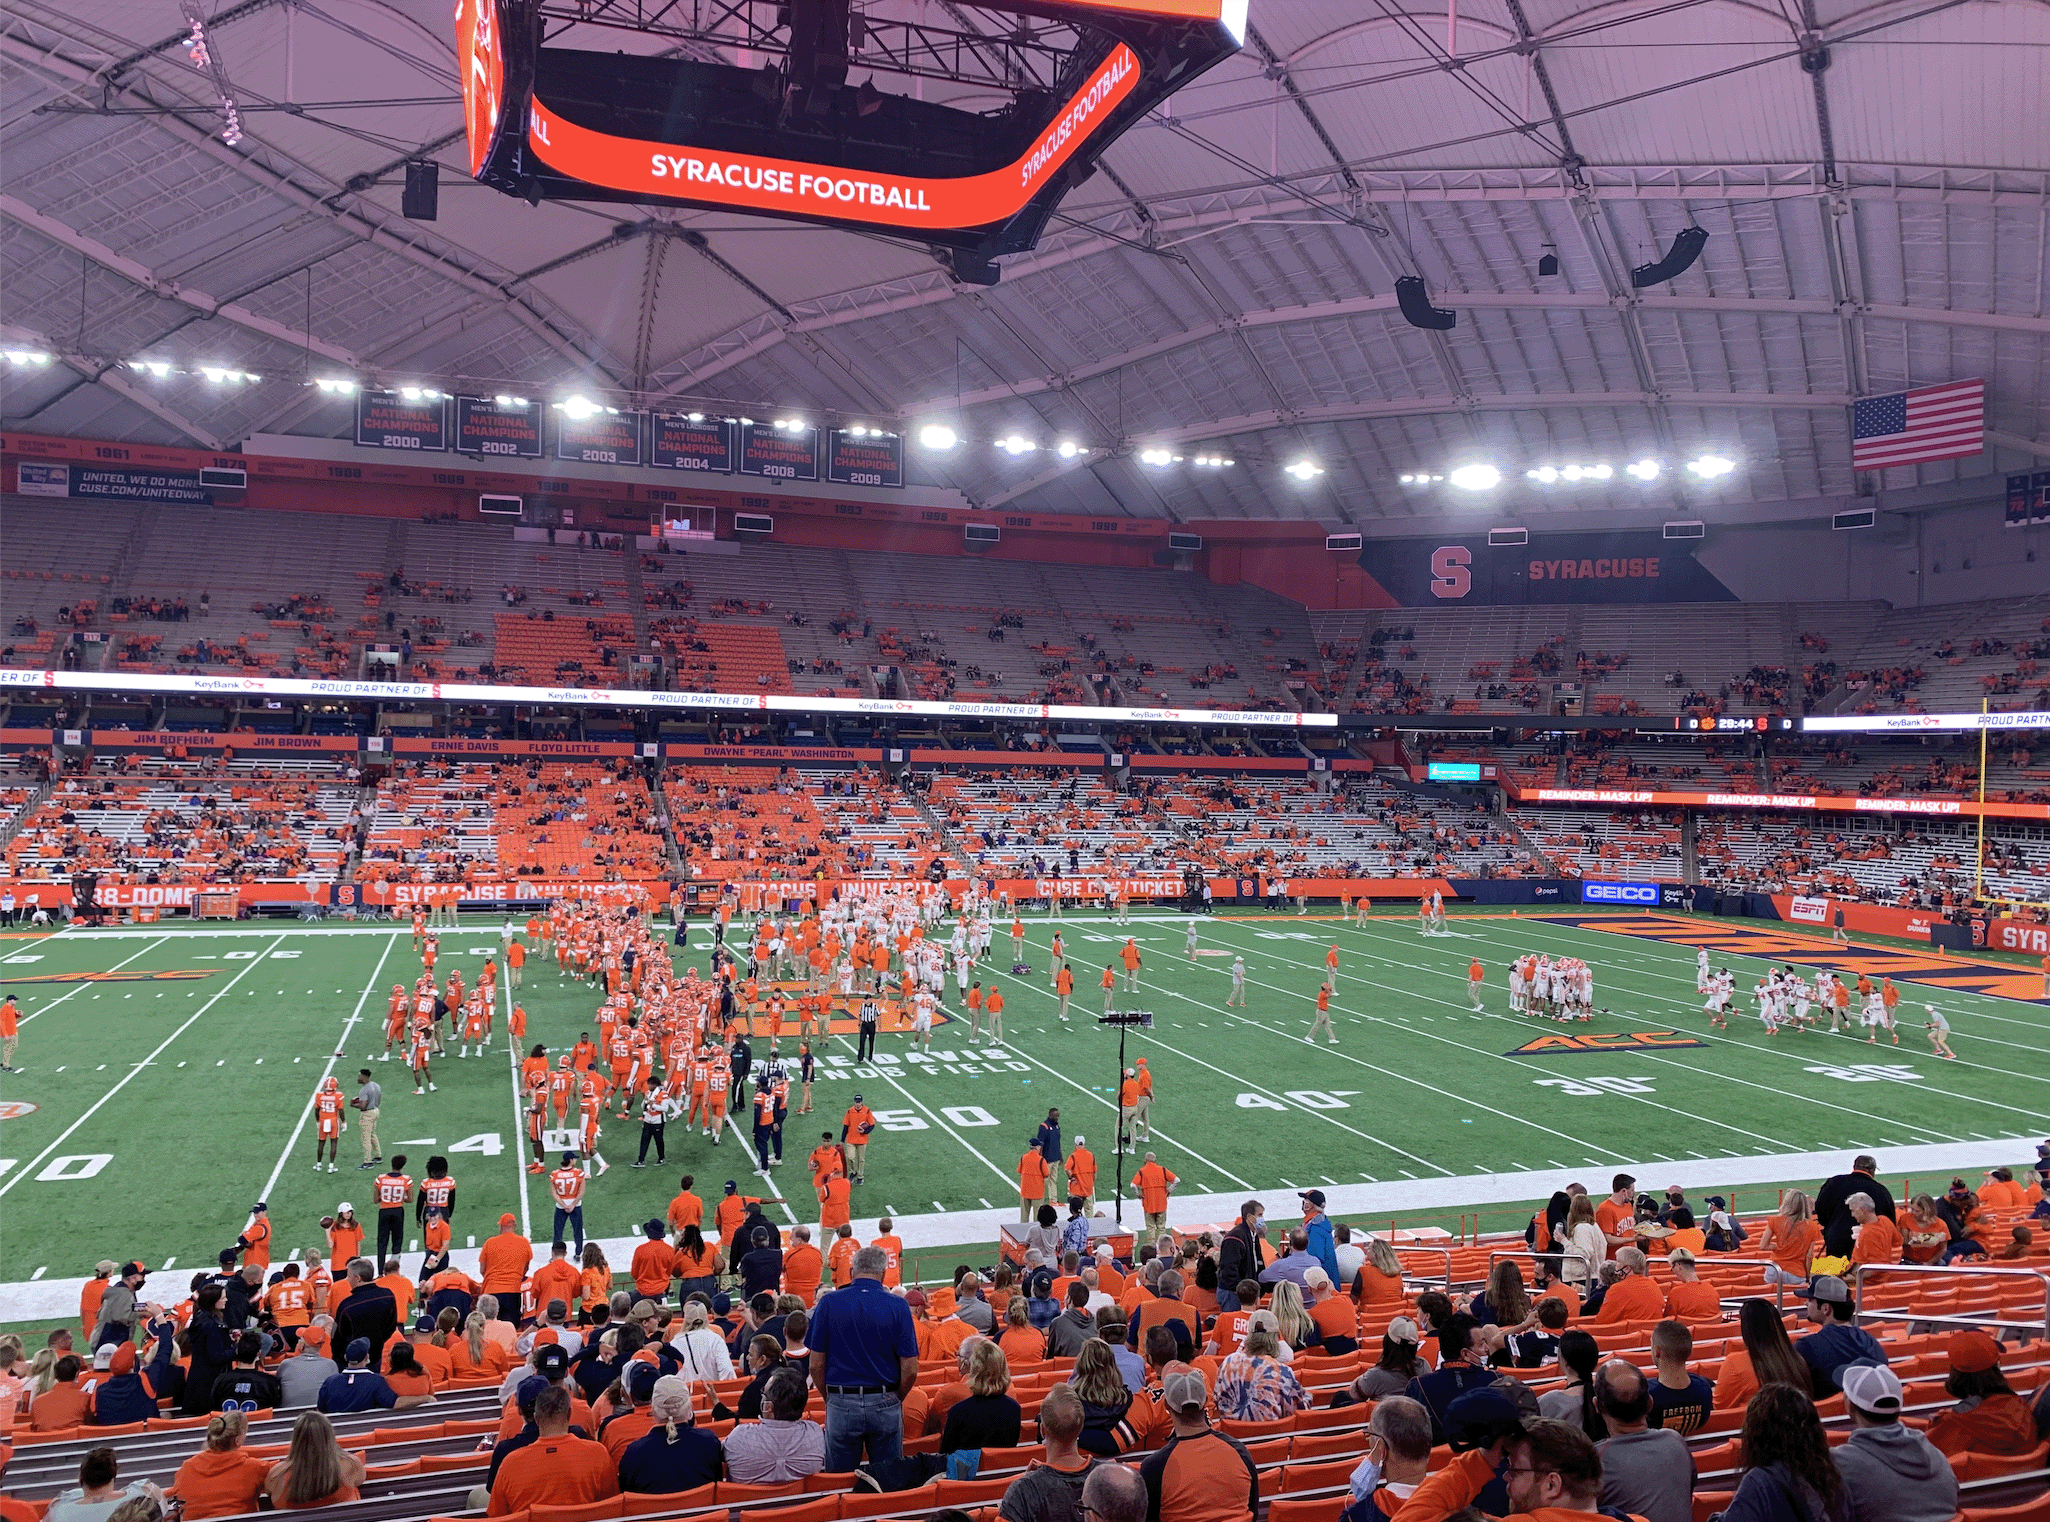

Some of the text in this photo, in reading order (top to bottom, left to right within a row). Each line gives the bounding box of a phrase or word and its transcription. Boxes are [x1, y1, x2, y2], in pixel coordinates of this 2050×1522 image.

[1022, 48, 1132, 187] SYRACUSE FOOTBALL
[651, 154, 931, 211] SYRACUSE FOOTBALL
[371, 408, 432, 421] NATIONAL
[470, 414, 529, 428] NATIONAL
[364, 418, 439, 433] CHAMPIONS
[463, 425, 536, 439] CHAMPIONS
[665, 421, 719, 431] MEN'S LACROSSE
[383, 435, 420, 448] 2000
[564, 433, 635, 448] CHAMPIONS
[664, 431, 721, 444] NATIONAL
[95, 446, 130, 460] 1961
[482, 442, 517, 454] 2002
[658, 441, 726, 455] CHAMPIONS
[753, 439, 807, 453] NATIONAL
[582, 450, 617, 463] 2003
[746, 448, 812, 464] CHAMPIONS
[840, 447, 892, 460] NATIONAL
[675, 456, 709, 469] 2004
[834, 456, 897, 471] CHAMPIONS
[21, 466, 47, 476] United
[32, 473, 47, 483] Way
[763, 464, 795, 478] 2008
[83, 472, 127, 484] UNITED,
[130, 475, 148, 485] WE
[150, 476, 166, 486] DO
[850, 472, 881, 485] 2009
[79, 483, 206, 500] CUSE.COM/UNITEDWAY
[646, 490, 677, 501] 1990
[741, 497, 770, 508] 1992
[921, 511, 948, 521] 1996
[1004, 516, 1031, 527] 1996
[1430, 545, 1472, 598] S
[1528, 558, 1660, 580] SYRACUSE
[84, 633, 100, 641] 317
[23, 674, 39, 684] OF
[44, 671, 55, 687] S
[194, 679, 240, 691] KeyBank
[311, 682, 442, 698] PROUD PARTNER OF S
[548, 691, 589, 702] KeyBank
[651, 694, 767, 709] PROUD PARTNER OF S
[858, 702, 894, 711] KeyBank
[948, 704, 1049, 718] PROUD PARTNER OF S
[1130, 710, 1163, 720] KeyBank
[1211, 712, 1303, 726] PROUD PARTNER OF S
[1689, 718, 1699, 729] 0
[1719, 718, 1753, 729] 29:44
[1783, 718, 1791, 729] 0
[1887, 718, 1921, 728] KeyBank
[1978, 715, 2013, 726] PROUD
[134, 735, 156, 744] JIM
[254, 737, 321, 748] JIM BROWN
[431, 742, 499, 752] ERNIE DAVIS
[529, 744, 600, 754] FLOYD LITTLE
[704, 747, 746, 757] DWAYNE
[791, 749, 855, 759] WASHINGTON
[1538, 790, 1653, 803] REMINDER: MASK UP!
[1707, 793, 1816, 807] REMINDER: MASK UP!
[1856, 799, 1960, 813] REMINDER: MASK UP!
[1241, 880, 1253, 896] S
[1542, 887, 1558, 896] pepsi
[1586, 885, 1656, 901] GEICO
[338, 886, 354, 905] S
[1793, 902, 1826, 915] ESPN
[2003, 926, 2048, 951] SYR
[418, 1001, 432, 1013] 60
[469, 1005, 482, 1016] 34
[601, 1011, 615, 1022] 50
[1517, 1031, 1700, 1051] ACC
[613, 1046, 629, 1057] 55
[644, 1052, 653, 1065] 16
[873, 1048, 1012, 1065] DAVIS
[695, 1068, 707, 1082] 91
[920, 1061, 1031, 1076] FIELD
[553, 1079, 566, 1092] 41
[710, 1077, 727, 1091] 95
[1533, 1076, 1656, 1095] 30
[1235, 1090, 1351, 1111] 40
[872, 1105, 1001, 1131] 50
[555, 1178, 577, 1195] 37
[381, 1185, 405, 1203] 89
[427, 1188, 450, 1204] 86
[279, 1290, 304, 1309] 15
[1662, 1404, 1703, 1418] FREEDOM
